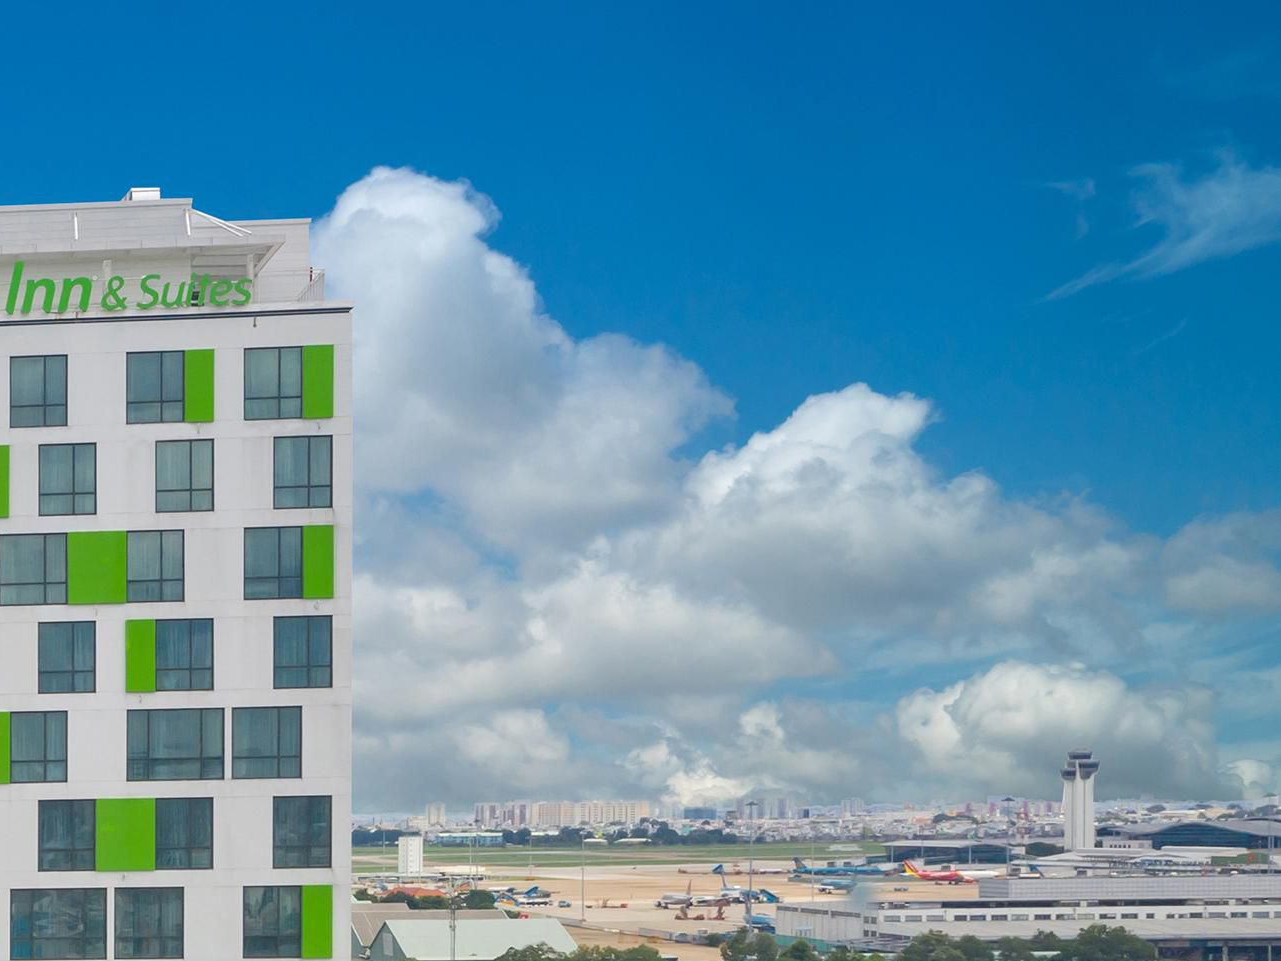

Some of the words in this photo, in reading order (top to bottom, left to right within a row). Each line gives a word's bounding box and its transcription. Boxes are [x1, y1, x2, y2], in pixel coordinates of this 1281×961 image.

[5, 260, 93, 315] Inn
[101, 275, 128, 312] &
[136, 271, 253, 310] Suites
